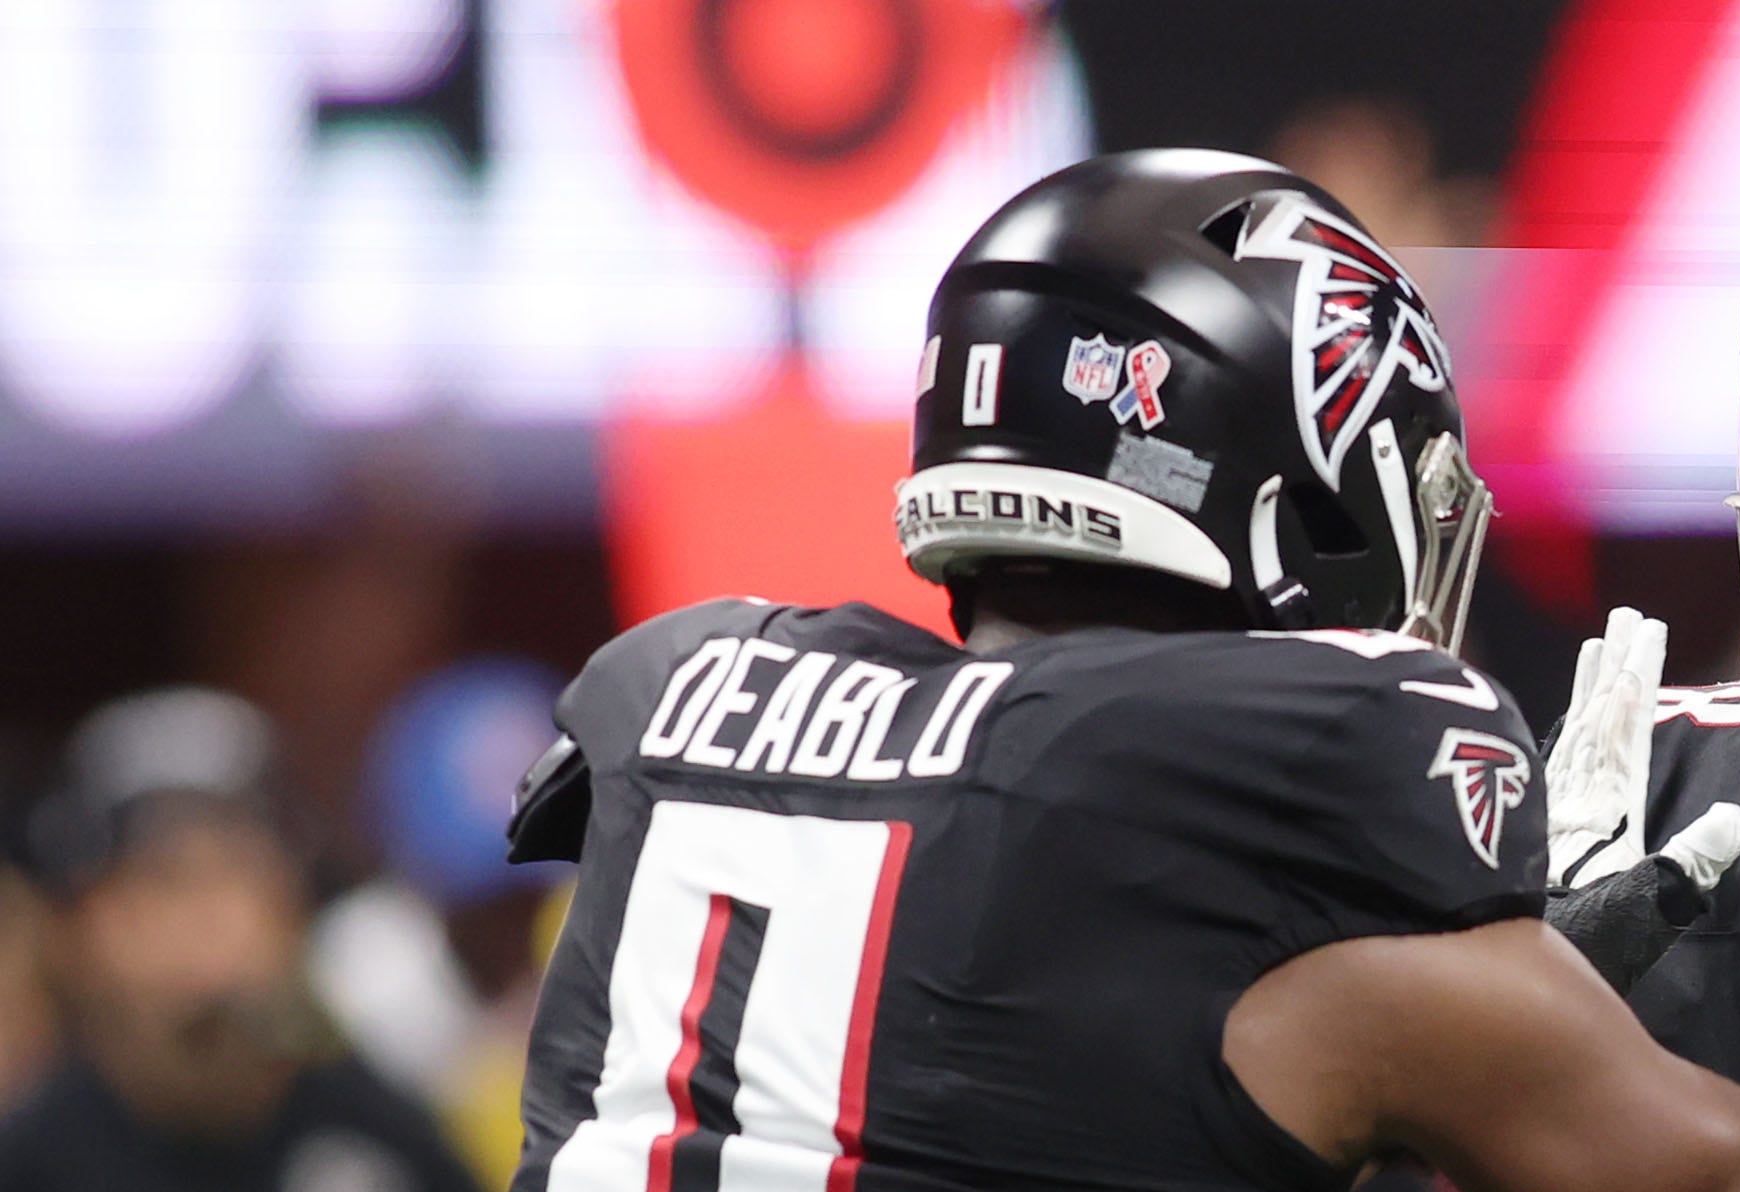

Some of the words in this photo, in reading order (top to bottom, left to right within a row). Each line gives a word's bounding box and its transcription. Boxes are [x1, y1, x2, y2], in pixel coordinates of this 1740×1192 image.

[962, 344, 1006, 426] 0
[1073, 364, 1113, 391] NFL
[639, 637, 1014, 780] DEABLO
